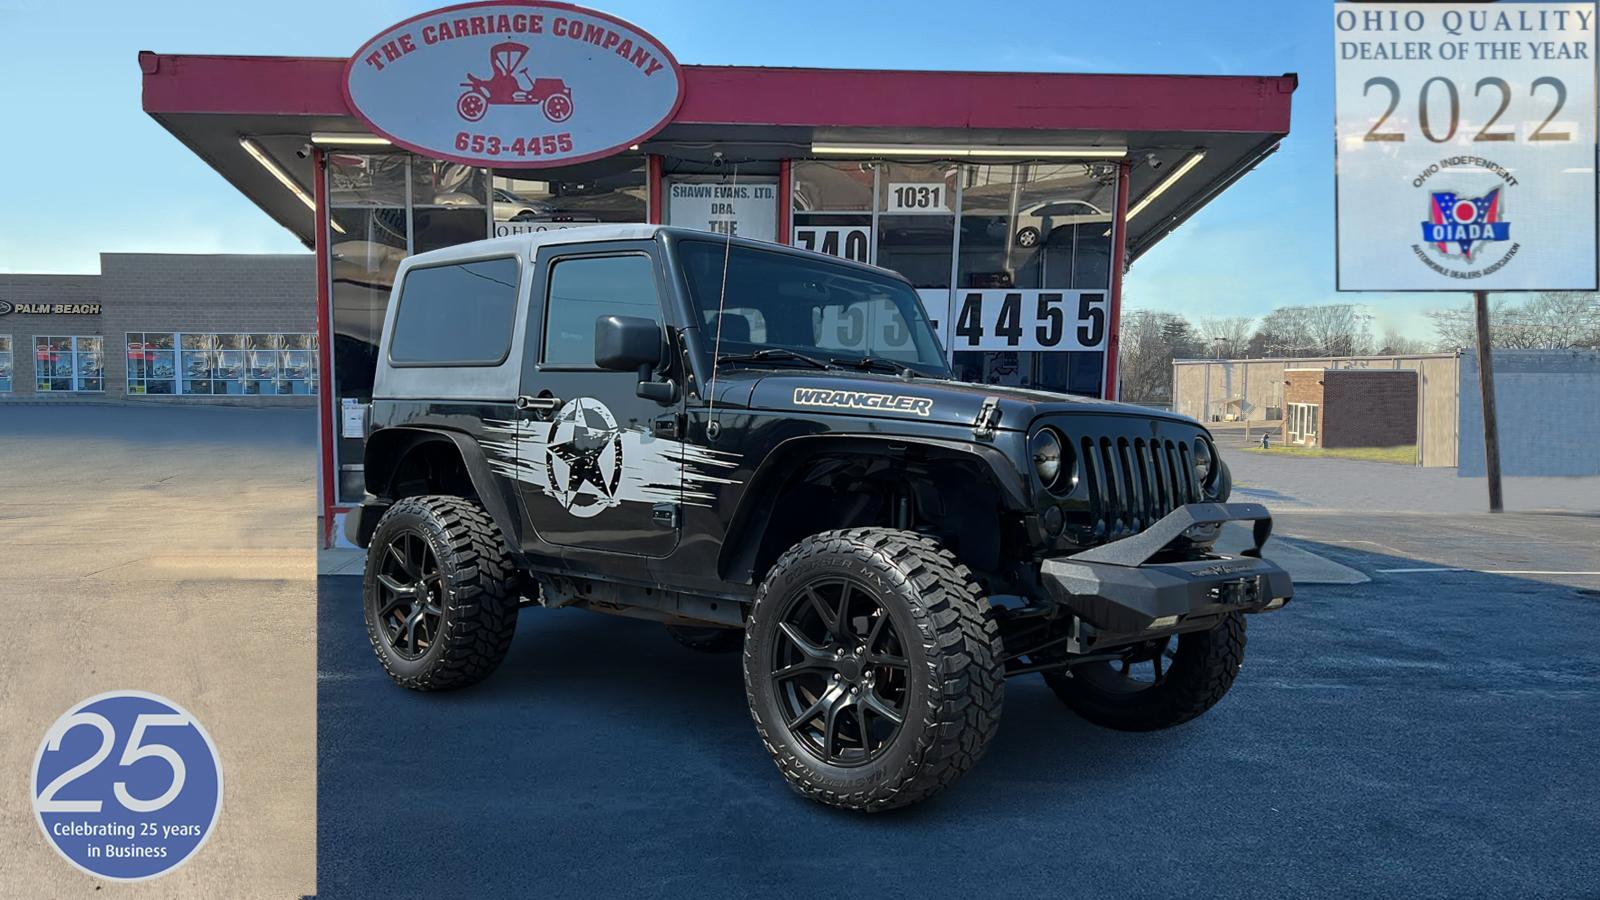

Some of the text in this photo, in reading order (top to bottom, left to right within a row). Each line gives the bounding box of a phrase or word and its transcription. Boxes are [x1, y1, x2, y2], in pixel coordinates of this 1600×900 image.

[1336, 10, 1593, 35] OHIO QUALITY
[365, 14, 664, 77] THE CARRIAGE COMPANY
[1340, 41, 1589, 60] DEALER OF THE YEAR
[1363, 76, 1571, 143] 2022
[455, 132, 573, 157] 653-4455
[1412, 155, 1519, 188] OHIO INDEPENDENT
[673, 186, 711, 198] SHAWN
[754, 187, 775, 199] LTD.
[894, 186, 941, 208] 1031
[711, 203, 736, 215] DBA.
[709, 221, 738, 235] THE
[1432, 224, 1495, 240] OIADA
[1411, 242, 1520, 280] AUTOMOBILE DEALERS ASSOCIATION
[15, 304, 101, 314] PALM BEACH
[794, 388, 933, 416] WRANGLER
